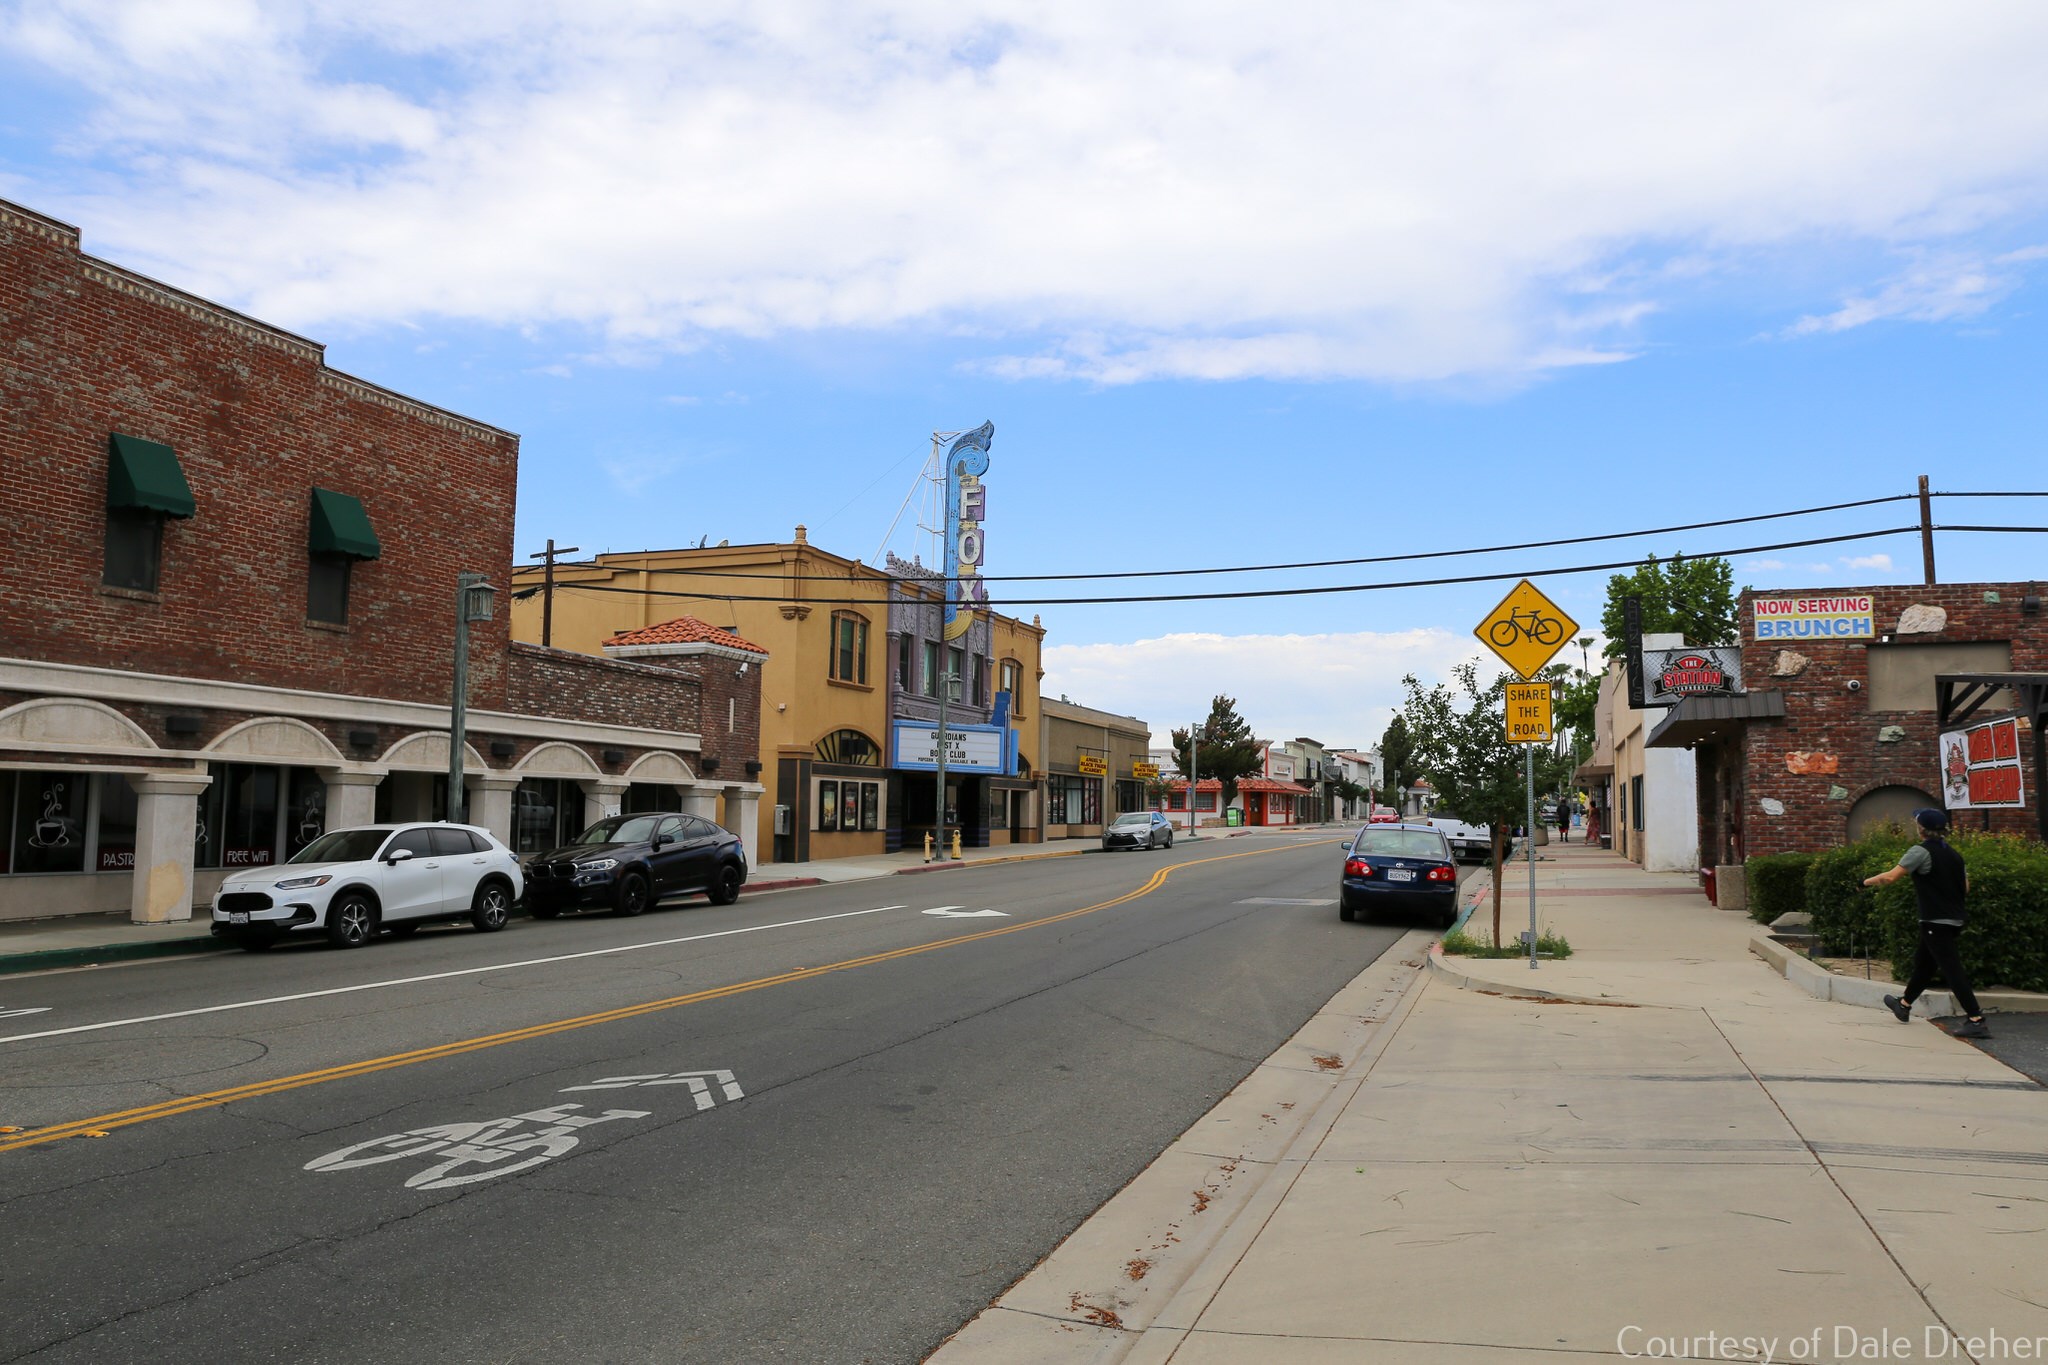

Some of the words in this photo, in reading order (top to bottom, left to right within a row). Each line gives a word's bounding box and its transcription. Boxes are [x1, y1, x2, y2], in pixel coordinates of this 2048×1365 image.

[957, 487, 982, 608] FOX
[1756, 600, 1793, 615] NOW
[1797, 597, 1870, 613] SERVING
[1757, 618, 1871, 637] BRUNCH
[1663, 670, 1721, 687] STATION
[1510, 688, 1547, 701] SHARE
[1518, 706, 1540, 718] THE
[1514, 723, 1545, 735] ROAD
[931, 732, 967, 741] GURDIANS
[955, 742, 960, 750] X
[930, 749, 947, 758] BO
[103, 853, 135, 866] PASTR
[227, 851, 249, 863] FREE
